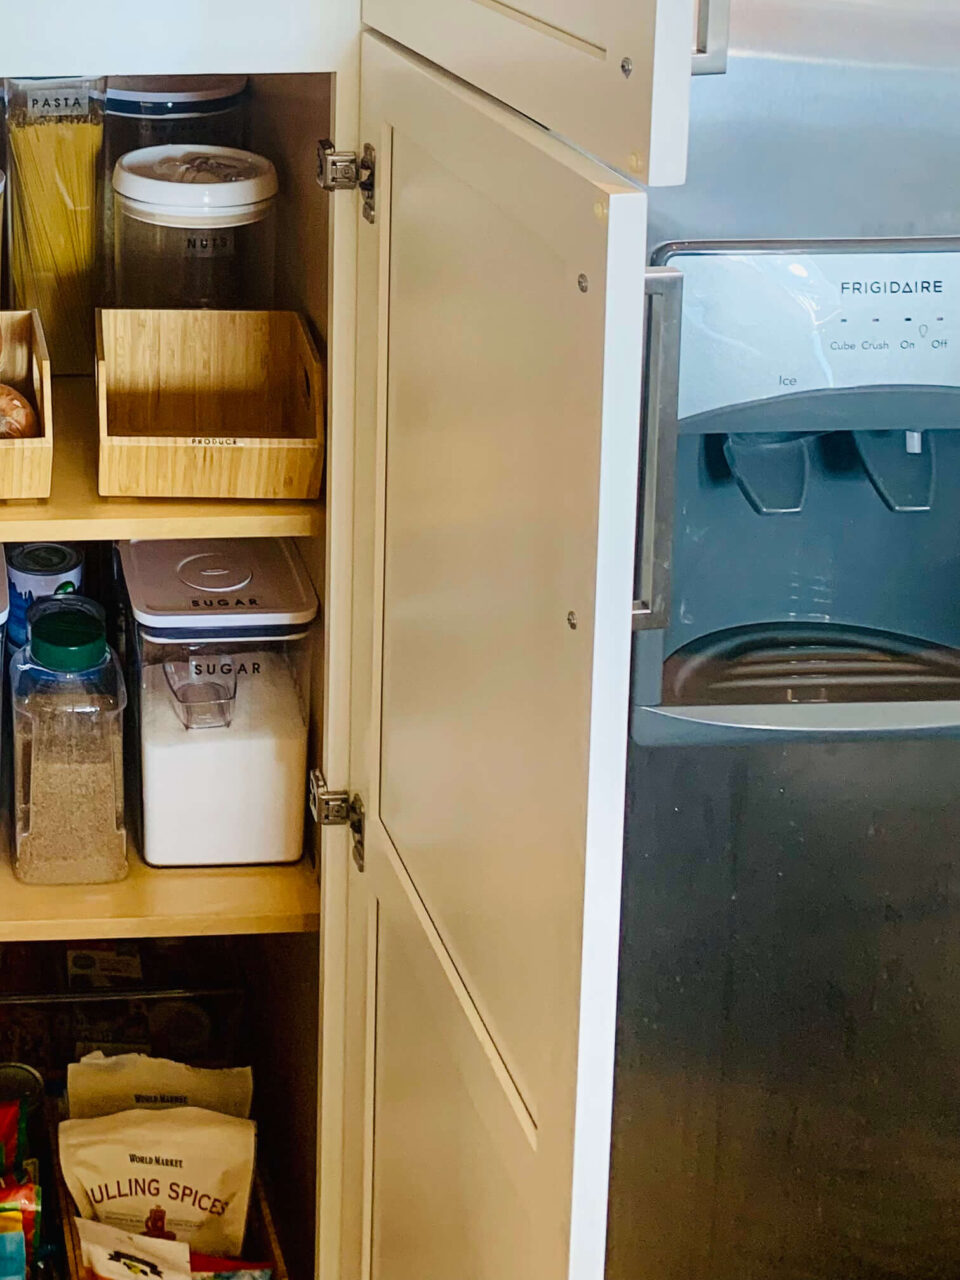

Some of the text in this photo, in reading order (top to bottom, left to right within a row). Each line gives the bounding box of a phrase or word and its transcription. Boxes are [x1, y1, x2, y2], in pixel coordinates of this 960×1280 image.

[31, 96, 82, 109] PASTA
[187, 238, 228, 249] NUTS
[841, 280, 943, 294] FRIGIDAIRE
[830, 340, 889, 351] Cube Crush
[900, 339, 948, 350] On Off
[779, 375, 798, 387] Ice
[191, 597, 259, 609] SUGAR
[194, 661, 262, 677] SUGAR
[134, 1094, 188, 1104] WORLD MARKET
[129, 1153, 183, 1168] WORLD MARKET
[168, 1182, 229, 1216] SPICES
